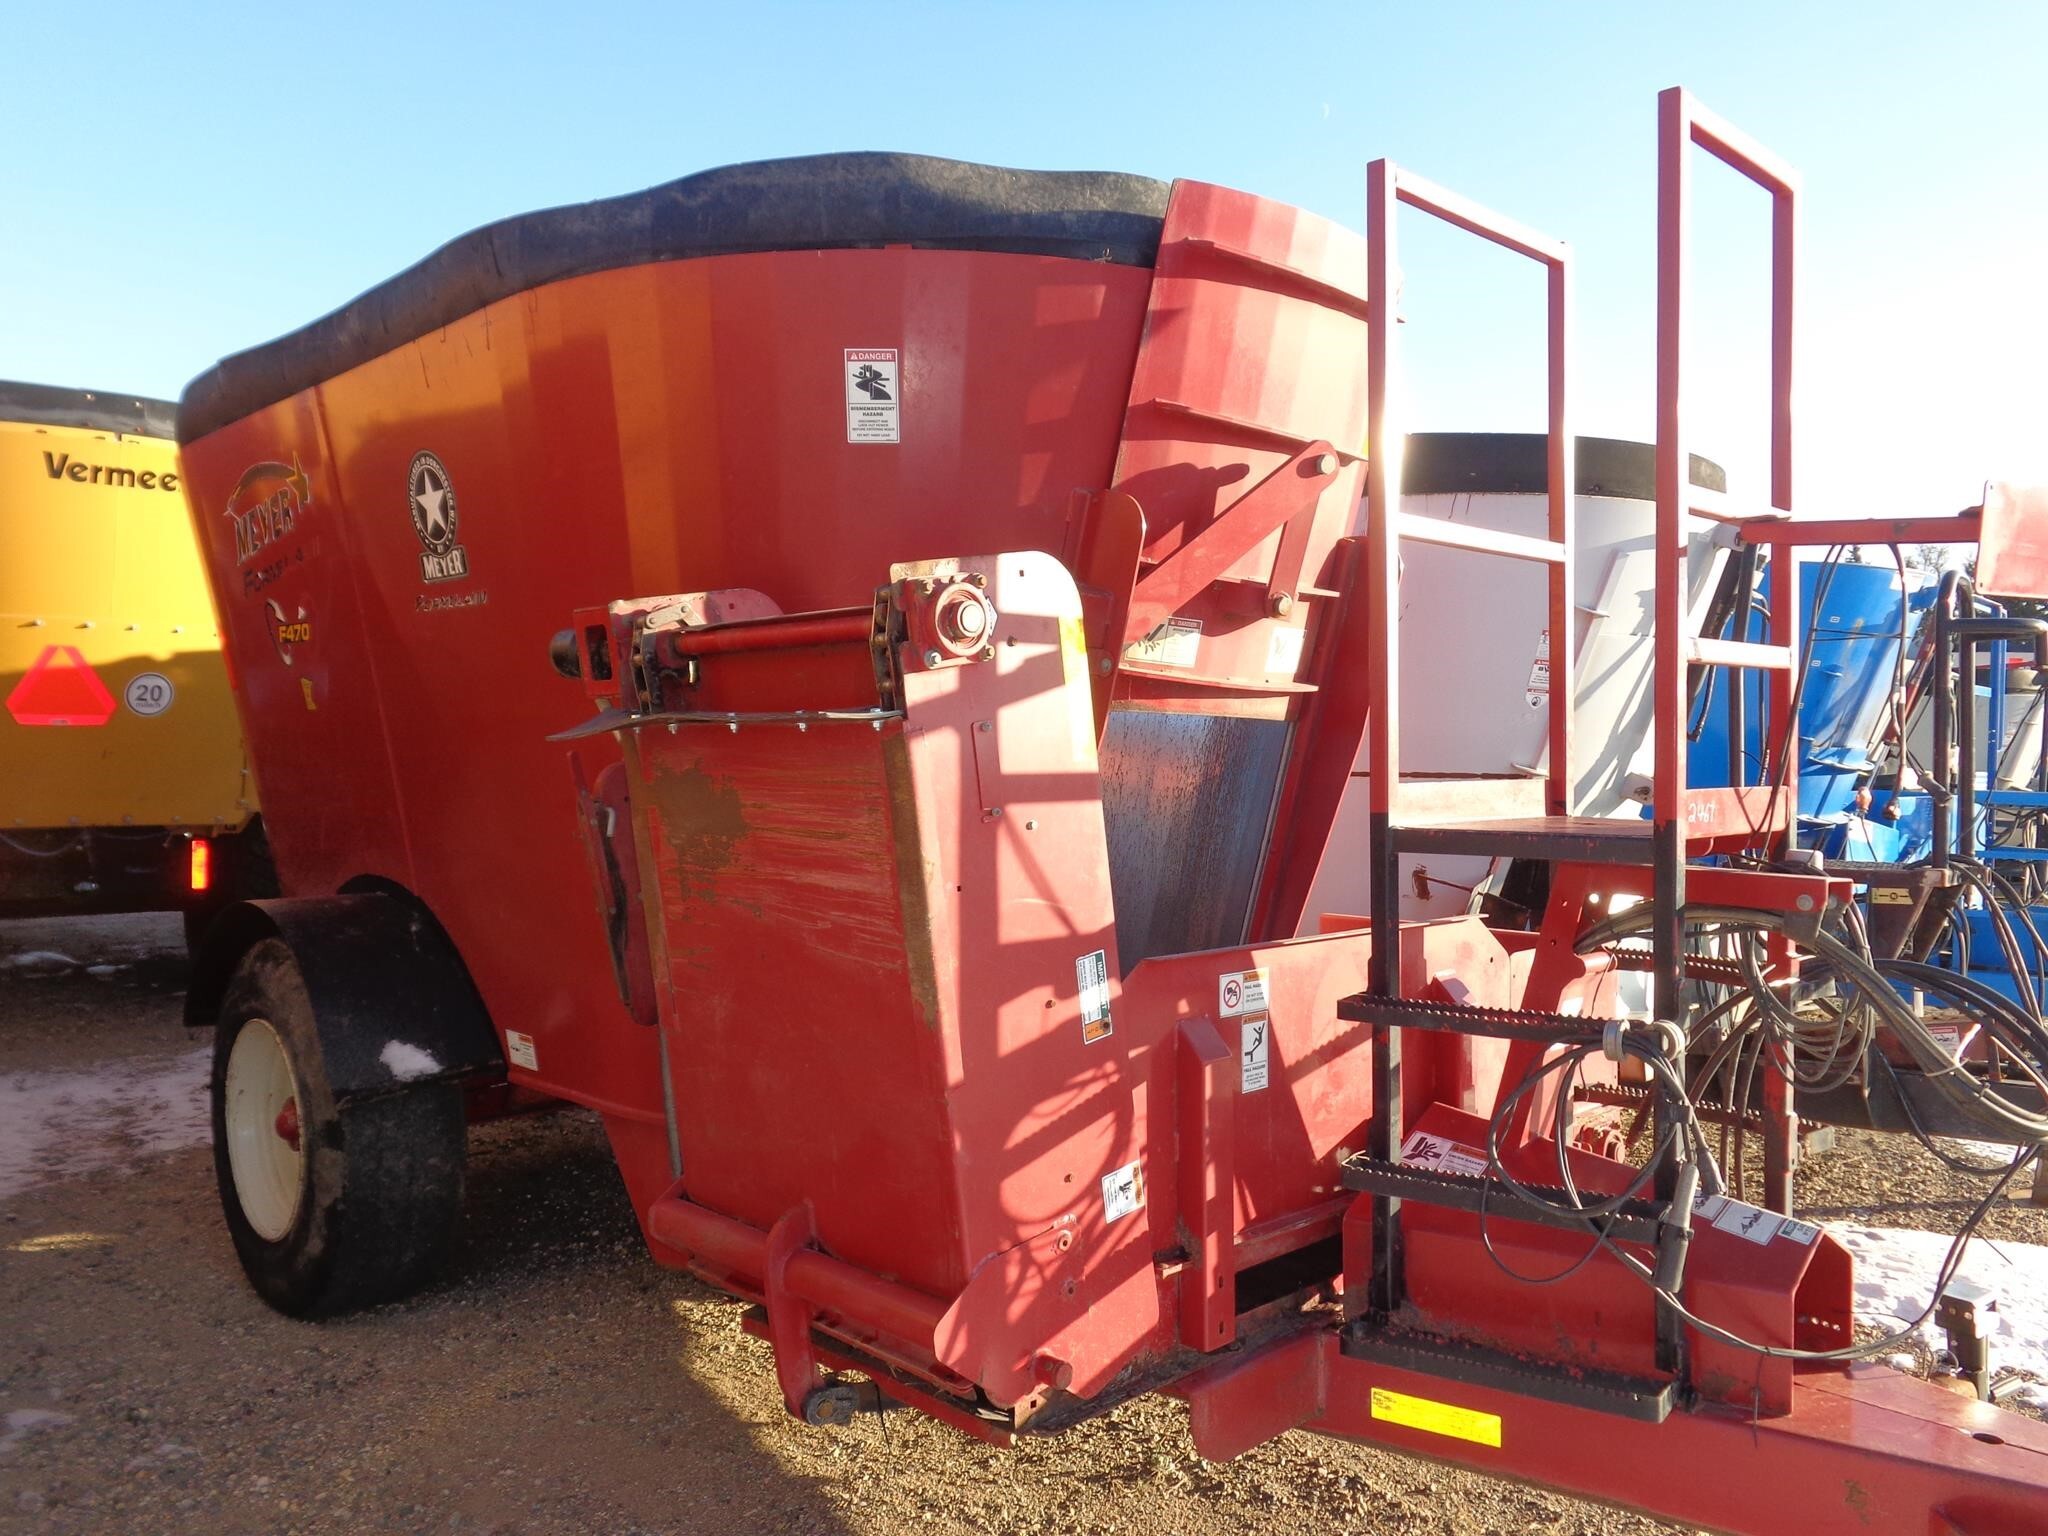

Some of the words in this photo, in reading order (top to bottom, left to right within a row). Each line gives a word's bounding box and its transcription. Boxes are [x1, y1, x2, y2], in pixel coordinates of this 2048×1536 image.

[858, 352, 892, 361] DANGER
[42, 450, 180, 492] Vermee
[234, 486, 294, 567] MEYER
[422, 549, 464, 580] MEYER
[279, 624, 311, 642] F470
[136, 684, 162, 702] 20
